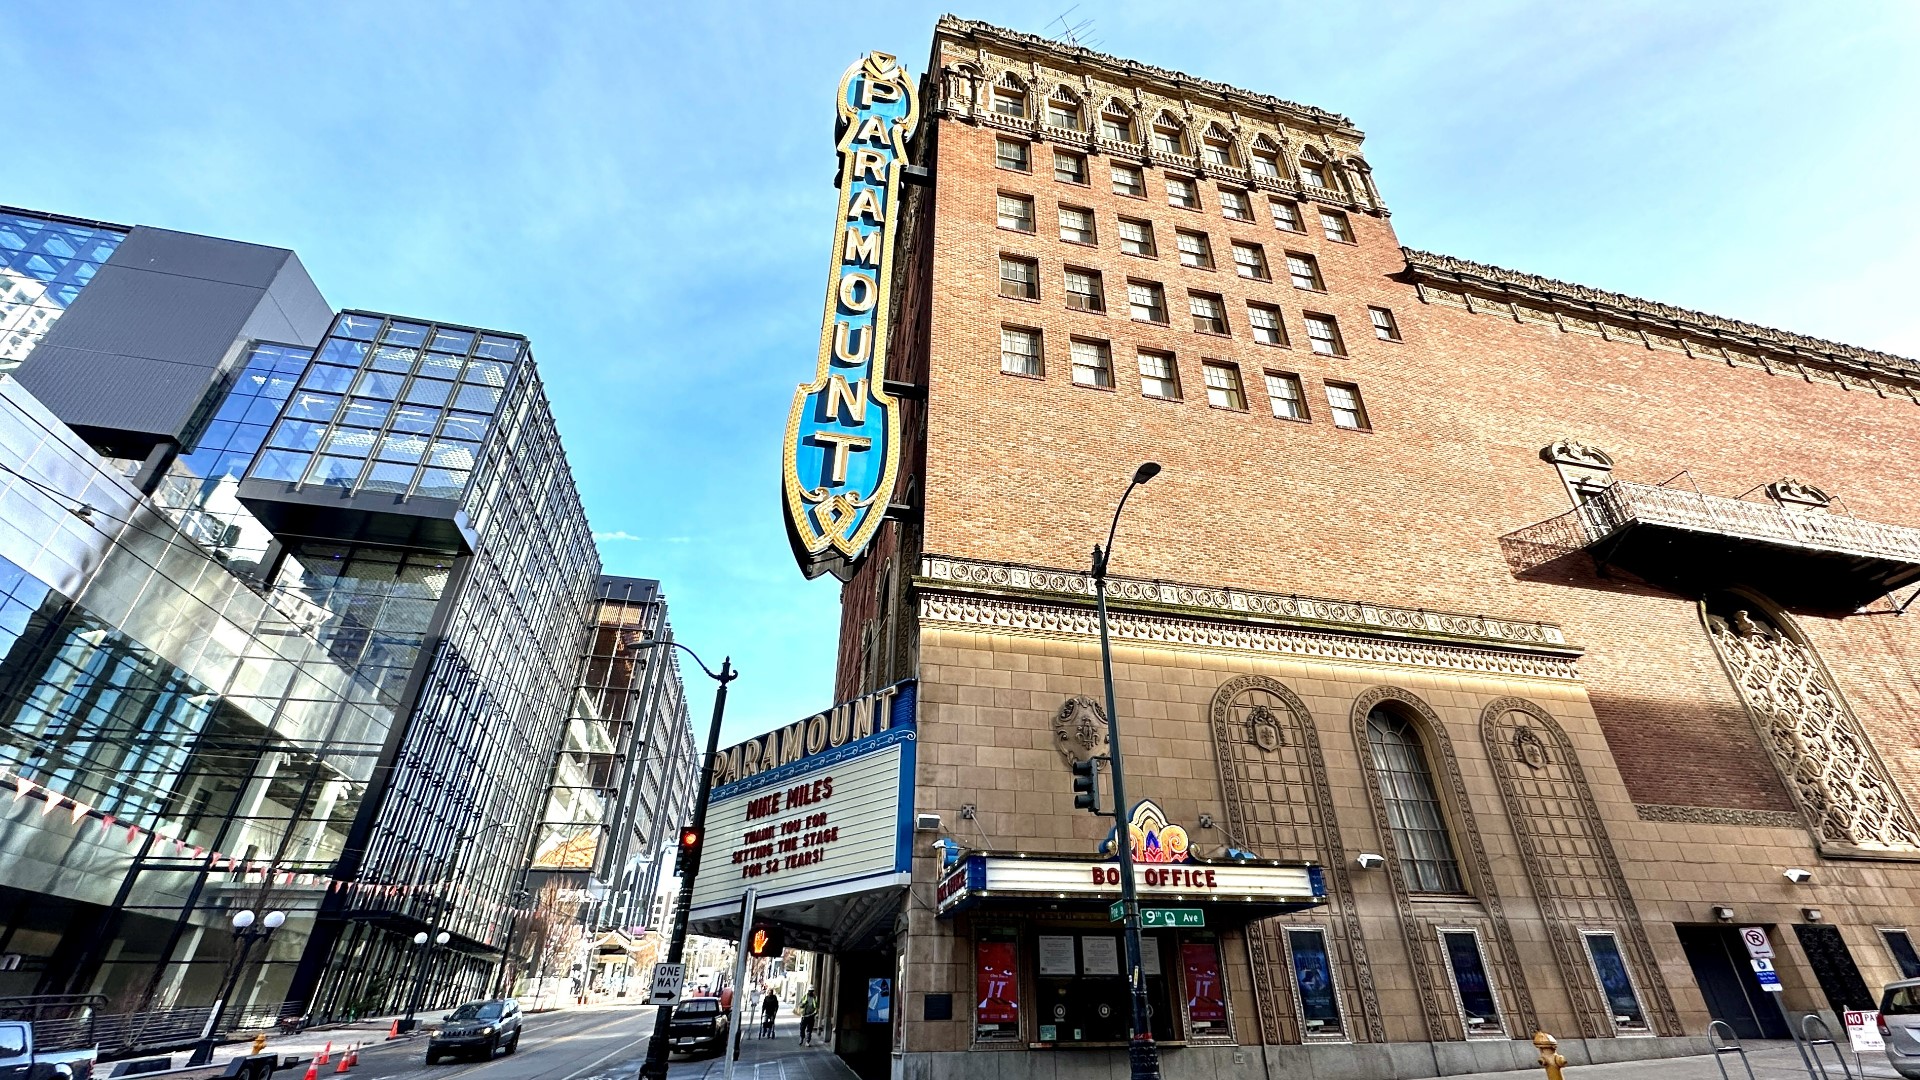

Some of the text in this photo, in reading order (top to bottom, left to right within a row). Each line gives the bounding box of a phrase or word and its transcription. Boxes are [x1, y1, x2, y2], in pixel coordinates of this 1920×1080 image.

[815, 78, 900, 487] PARAMOUNT
[711, 685, 897, 788] PARAMOUNT
[745, 776, 833, 822] MIKE MILES
[744, 812, 828, 845] THANK YOU FOR
[731, 826, 839, 864] SETTING THE STAGE
[742, 862, 762, 879] FOR
[784, 847, 824, 869] YEARS!
[1092, 867, 1218, 888] BO OFFICE
[1145, 910, 1199, 924] 9th Ave
[657, 977, 680, 987] WAY
[660, 966, 681, 976] ONE
[1847, 1013, 1878, 1024] NO PA
